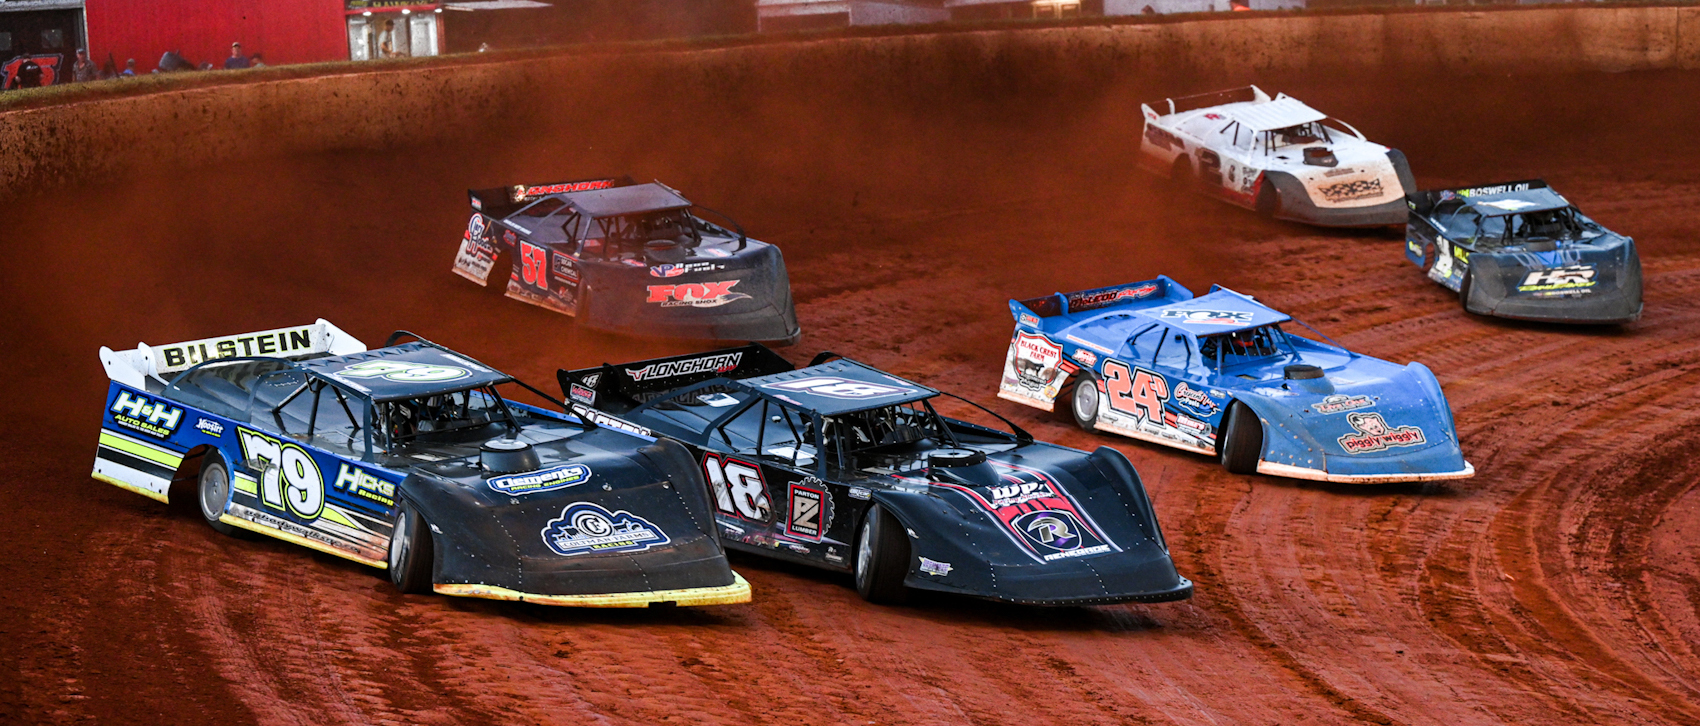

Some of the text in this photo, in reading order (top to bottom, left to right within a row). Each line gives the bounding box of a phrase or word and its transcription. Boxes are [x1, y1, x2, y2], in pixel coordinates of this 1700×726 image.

[1469, 185, 1513, 198] BOSWELL
[520, 240, 548, 290] 57
[646, 279, 740, 303] FOX
[1161, 309, 1254, 322] FOX
[163, 329, 311, 367] BILSTEIN
[1021, 340, 1057, 358] BLACK CREST
[1029, 350, 1045, 362] FARM
[333, 360, 473, 383] 79
[643, 352, 743, 380] LONGHORN
[758, 376, 919, 399] 18
[112, 390, 183, 430] H&H
[114, 414, 140, 426] AUTO
[140, 422, 170, 436] SALES
[1345, 430, 1419, 449] piggly wiggly
[237, 426, 325, 520] 79
[495, 467, 583, 489] Clements
[511, 475, 580, 492] RACING ENGINES
[702, 452, 776, 528] 18
[794, 489, 819, 500] PARTON
[612, 530, 650, 543] FARMS
[791, 525, 817, 536] LUMBER
[592, 540, 635, 549] RACING
